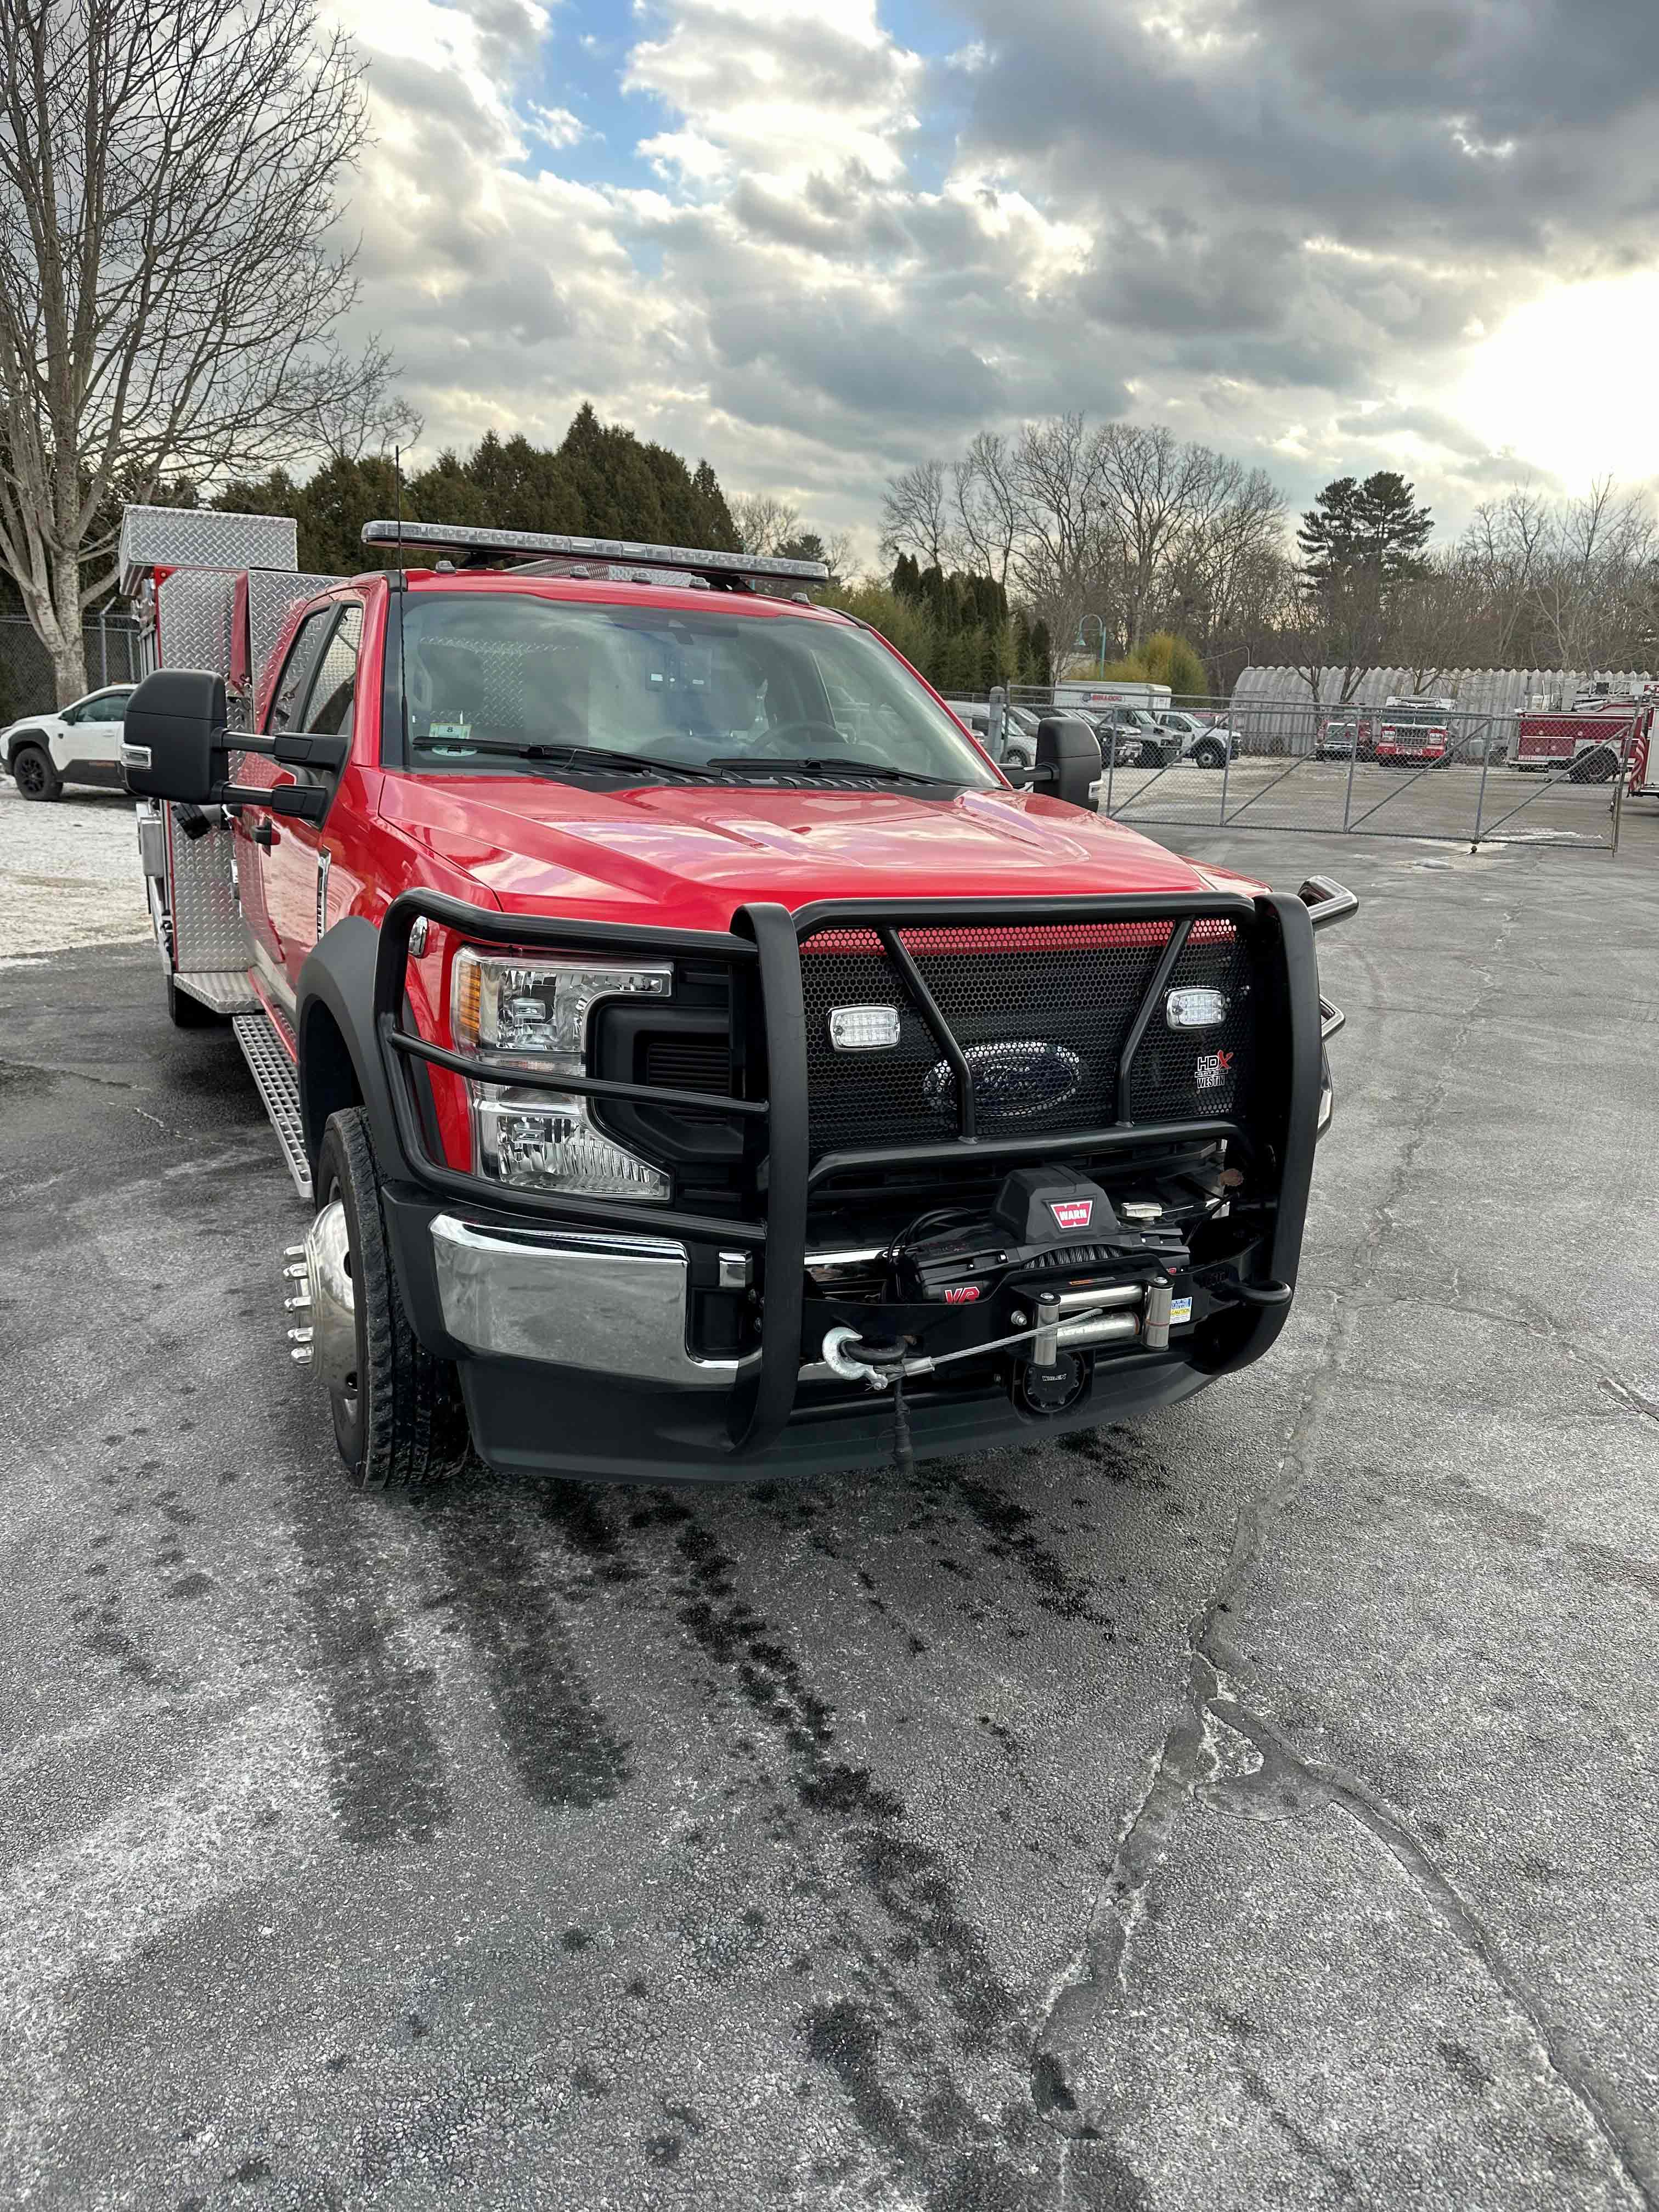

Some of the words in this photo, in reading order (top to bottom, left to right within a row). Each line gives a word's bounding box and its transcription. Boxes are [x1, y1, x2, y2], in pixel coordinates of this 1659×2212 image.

[1197, 1050, 1234, 1071] HDX
[1197, 1075, 1225, 1089] WESTIN
[1059, 1209, 1087, 1220] WARN
